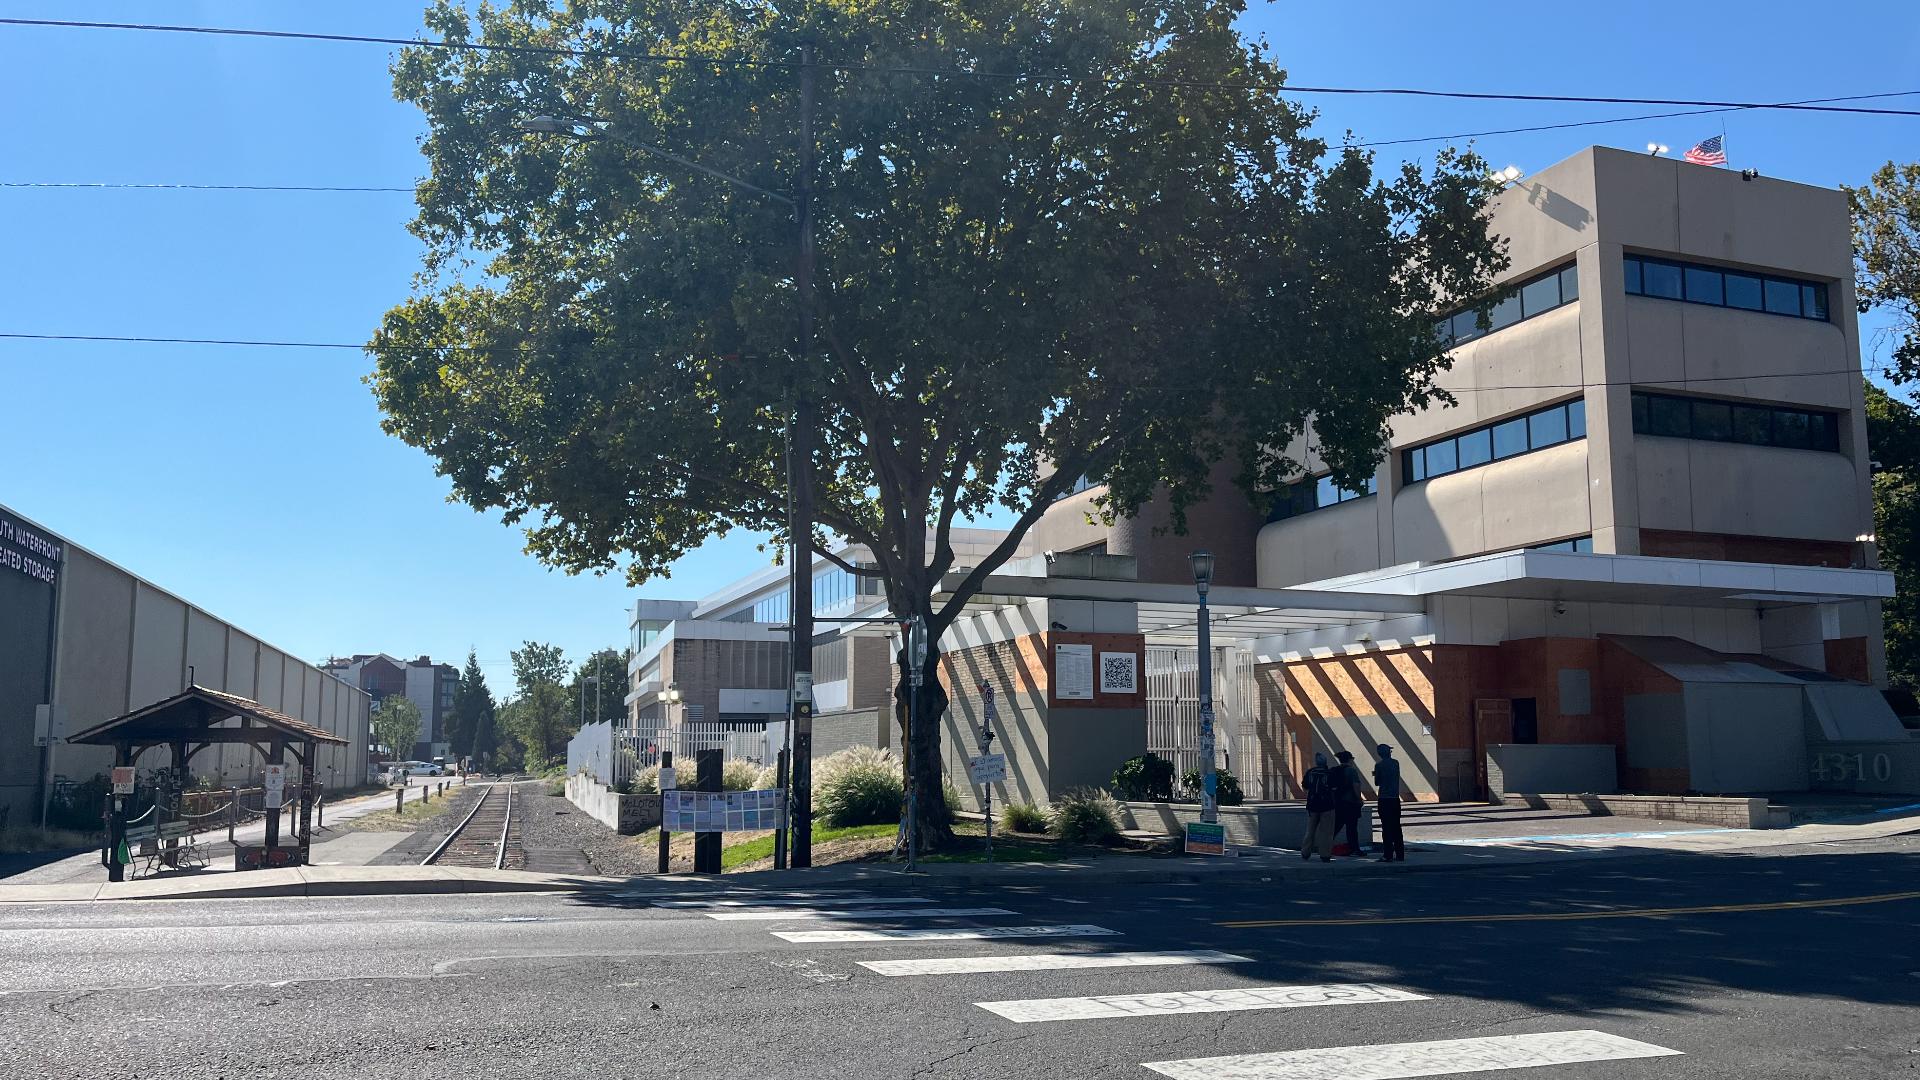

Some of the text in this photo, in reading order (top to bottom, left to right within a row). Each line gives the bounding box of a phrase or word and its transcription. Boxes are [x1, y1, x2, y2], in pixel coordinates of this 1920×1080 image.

[16, 526, 61, 562] WATERFRONT
[23, 556, 55, 584] STORAGE
[1810, 752, 1892, 782] 4310
